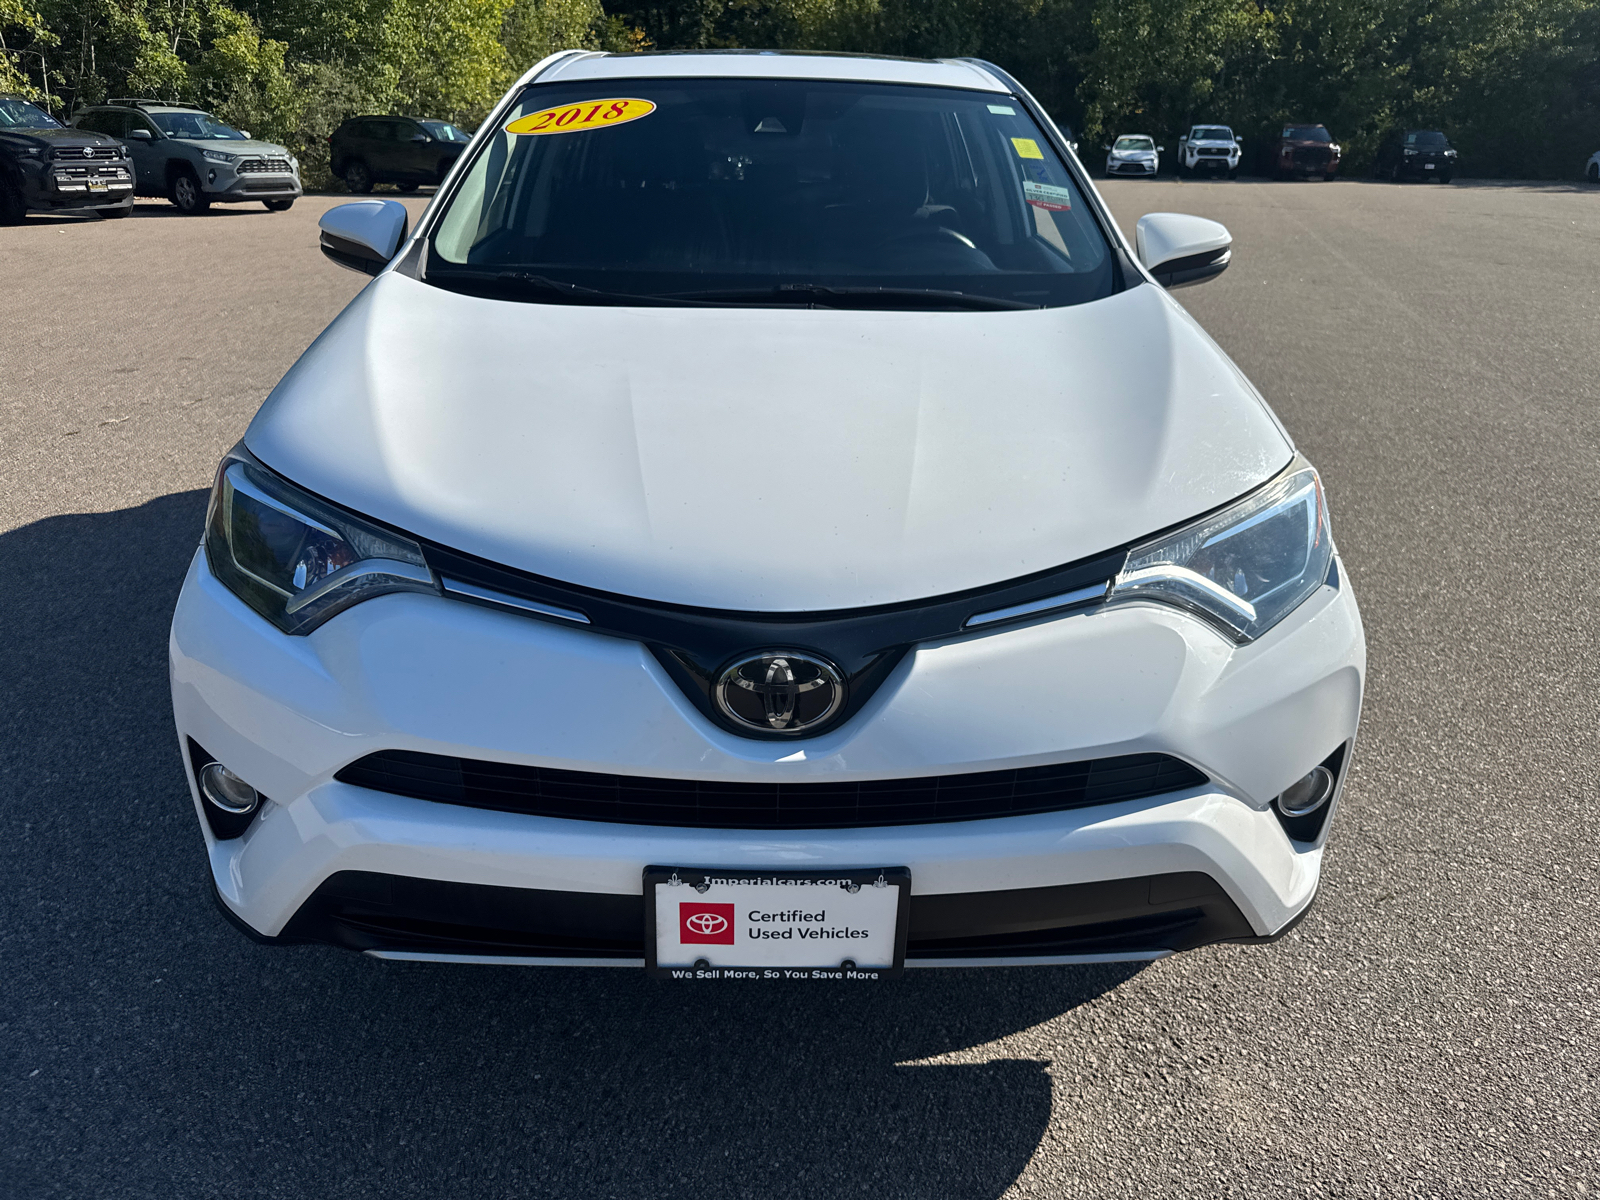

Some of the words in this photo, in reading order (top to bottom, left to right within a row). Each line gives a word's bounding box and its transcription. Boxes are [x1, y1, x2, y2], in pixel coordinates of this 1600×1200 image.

[527, 101, 630, 132] 2018
[703, 876, 852, 887] Imperialcars.com
[748, 910, 825, 922] Certified
[748, 927, 793, 939] Used
[797, 927, 869, 939] Vehicles
[671, 970, 693, 979] We
[696, 970, 719, 979] Sell
[724, 970, 760, 980] More,
[763, 970, 780, 979] So
[784, 970, 808, 979] You
[812, 970, 843, 979] Save
[846, 971, 879, 980] More
